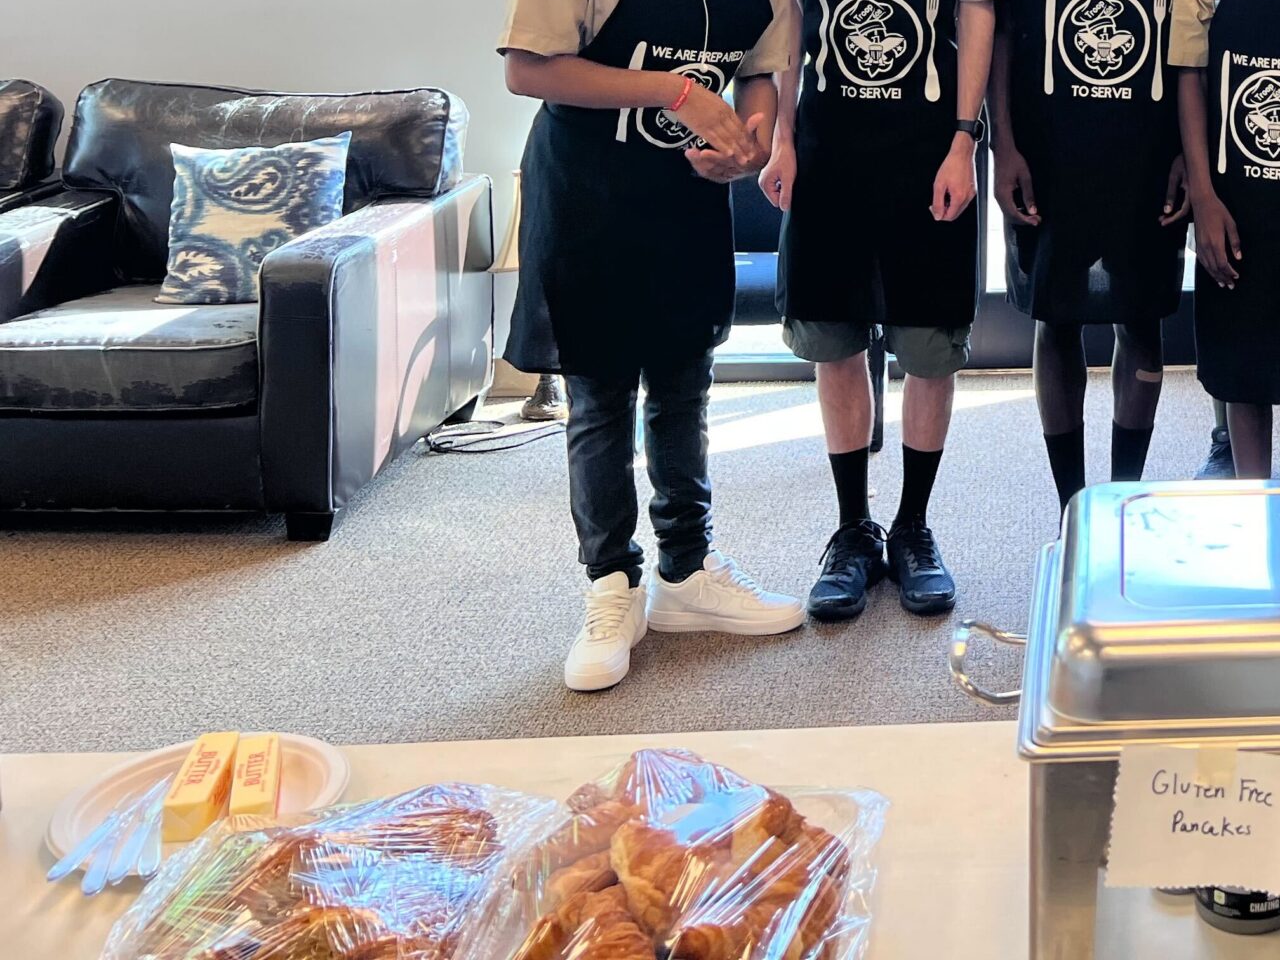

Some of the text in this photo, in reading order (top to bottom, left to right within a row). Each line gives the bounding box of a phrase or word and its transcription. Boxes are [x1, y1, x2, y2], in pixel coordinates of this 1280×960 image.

[853, 4, 874, 22] Troop
[1084, 0, 1105, 19] Troop
[652, 45, 743, 63] WE ARE PREPARED
[1232, 53, 1249, 66] WE
[1249, 56, 1270, 69] ARE
[840, 84, 858, 98] TO
[1071, 84, 1090, 97] TO
[1254, 83, 1275, 102] Troop
[1243, 164, 1261, 178] TO
[243, 751, 265, 787] BUTTER
[1152, 769, 1273, 807] Gluten Free
[1249, 899, 1280, 913] CHAFING
